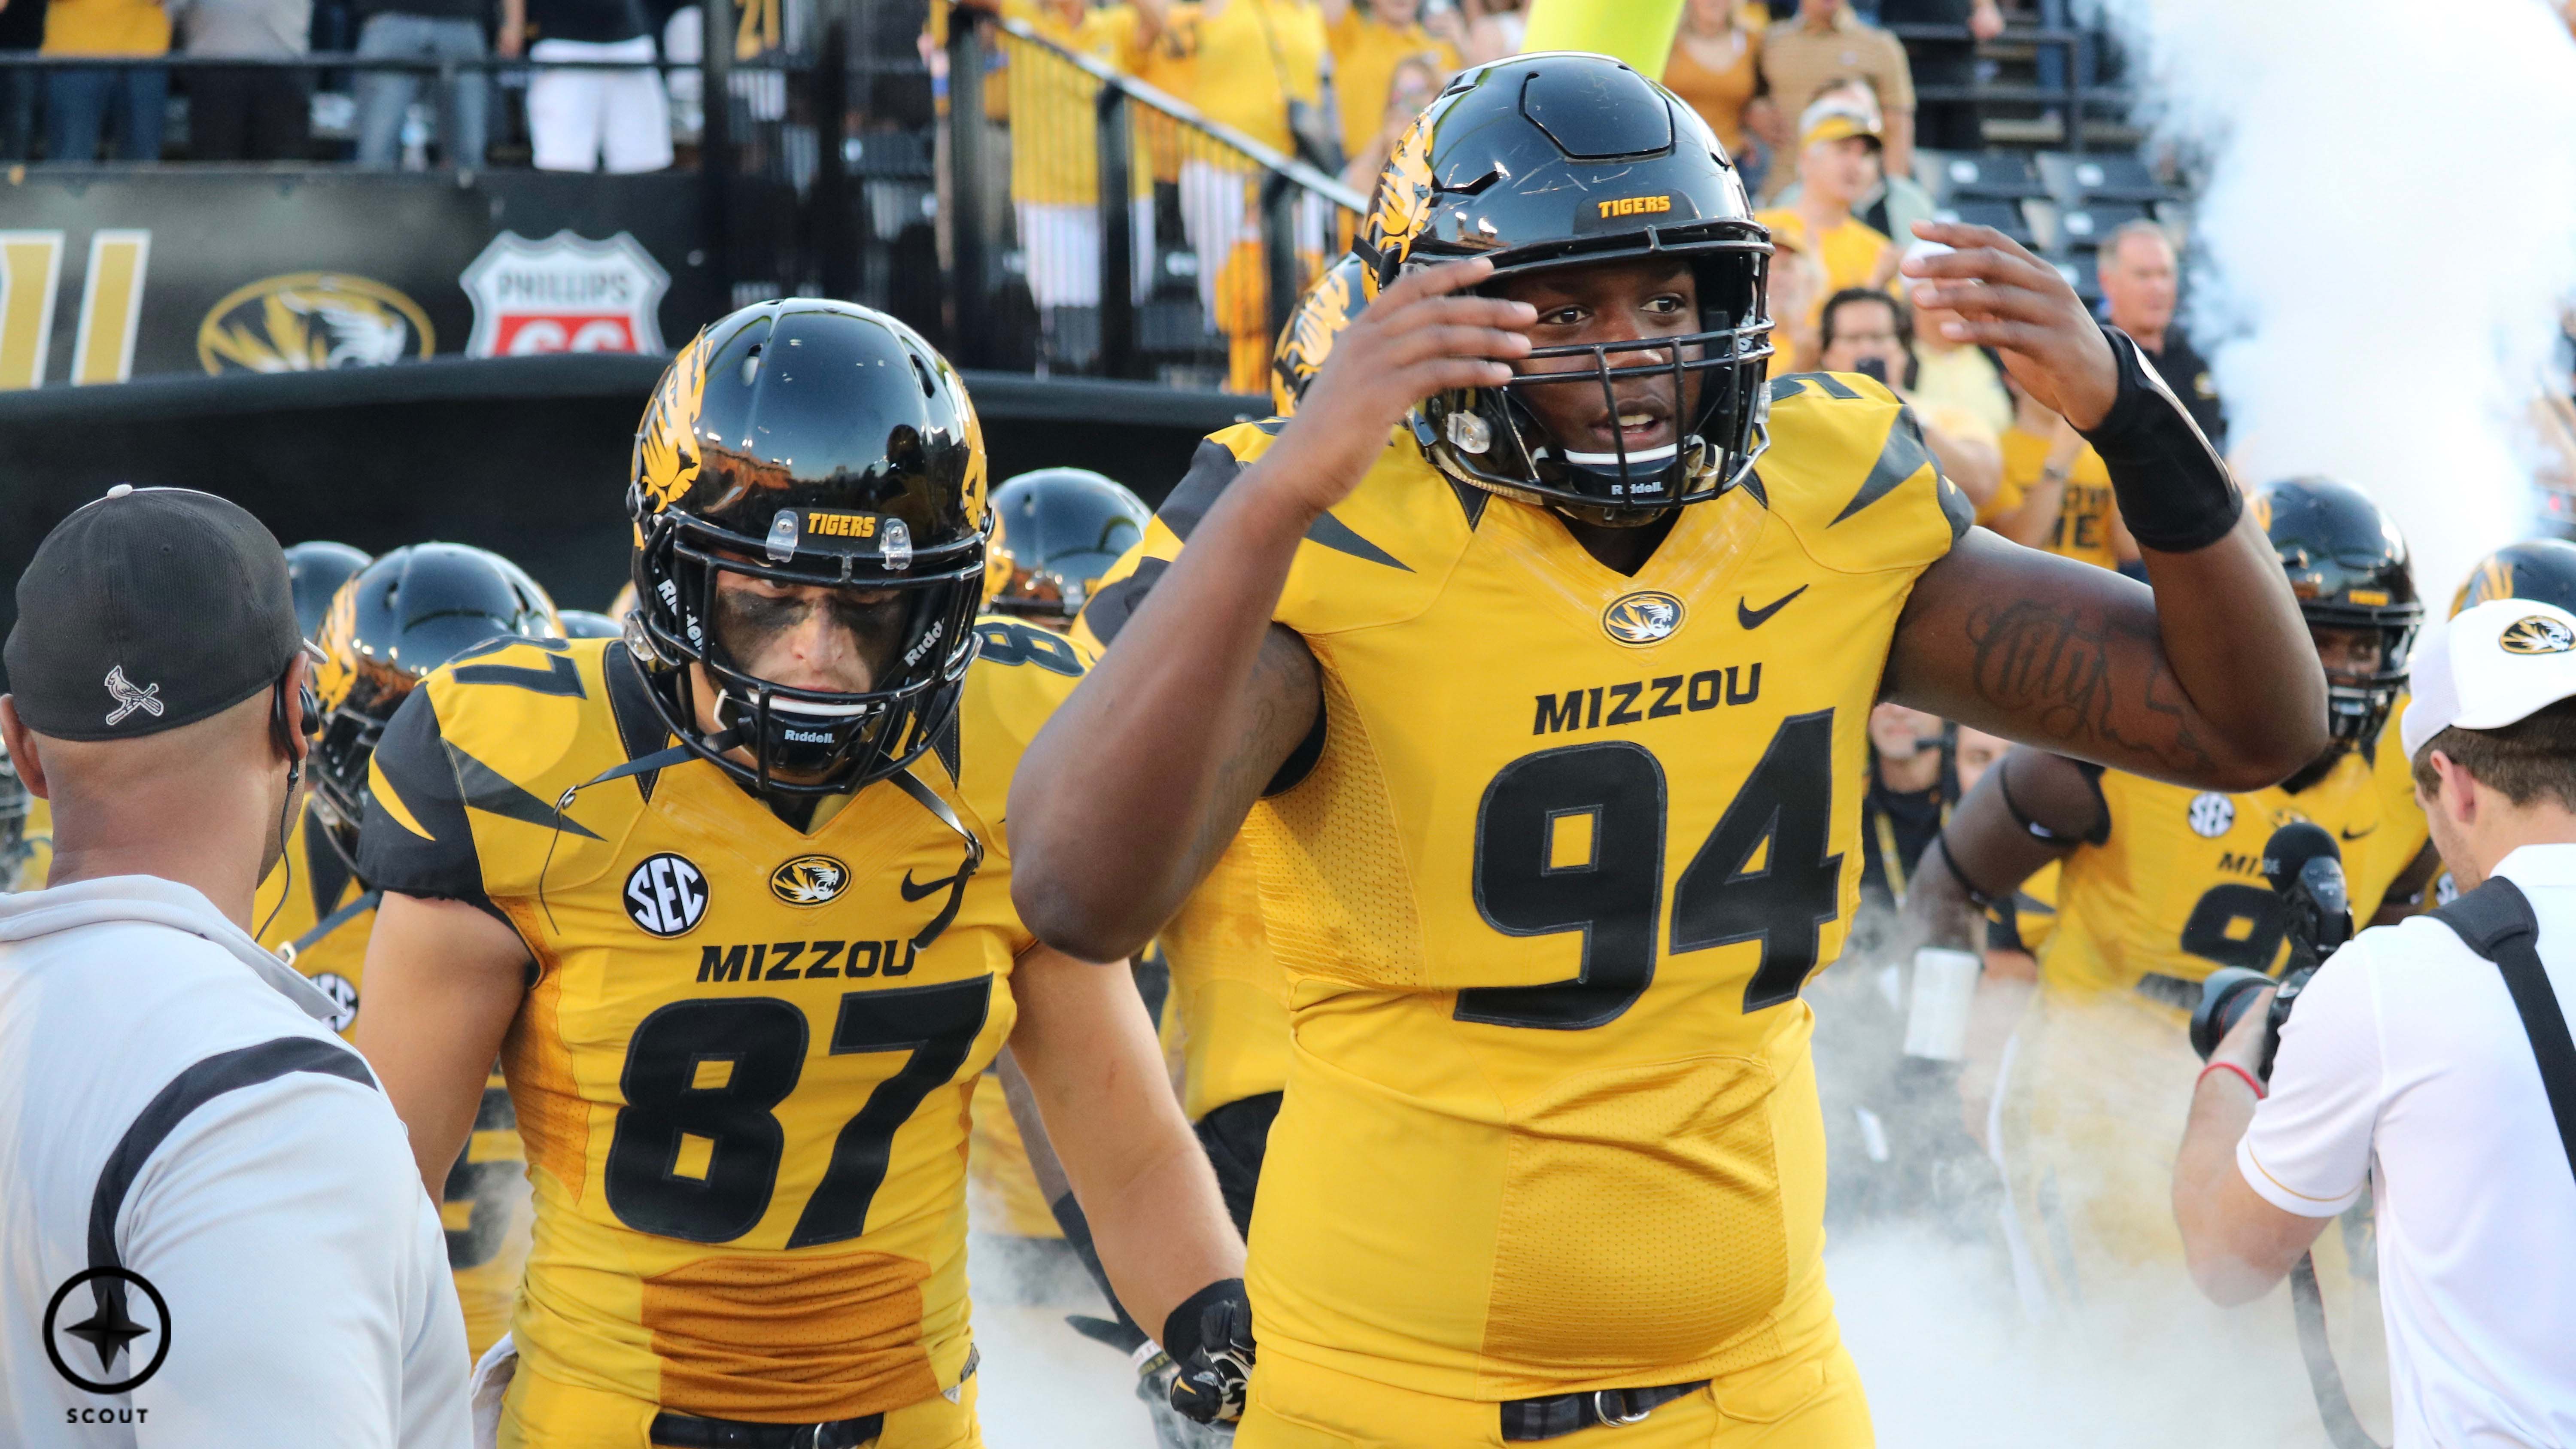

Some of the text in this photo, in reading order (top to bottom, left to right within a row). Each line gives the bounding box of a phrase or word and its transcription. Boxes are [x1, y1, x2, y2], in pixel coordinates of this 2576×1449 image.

[1598, 195, 1671, 219] TIGERS
[498, 272, 629, 302] PHILLIPS
[808, 513, 876, 538] TIGERS
[1533, 662, 1762, 735] MIZZOU
[2189, 792, 2235, 837] SEC
[1453, 707, 1844, 1030] 94
[627, 857, 708, 935] SEC
[696, 940, 915, 981] MIZZOU
[605, 972, 994, 1250] 87
